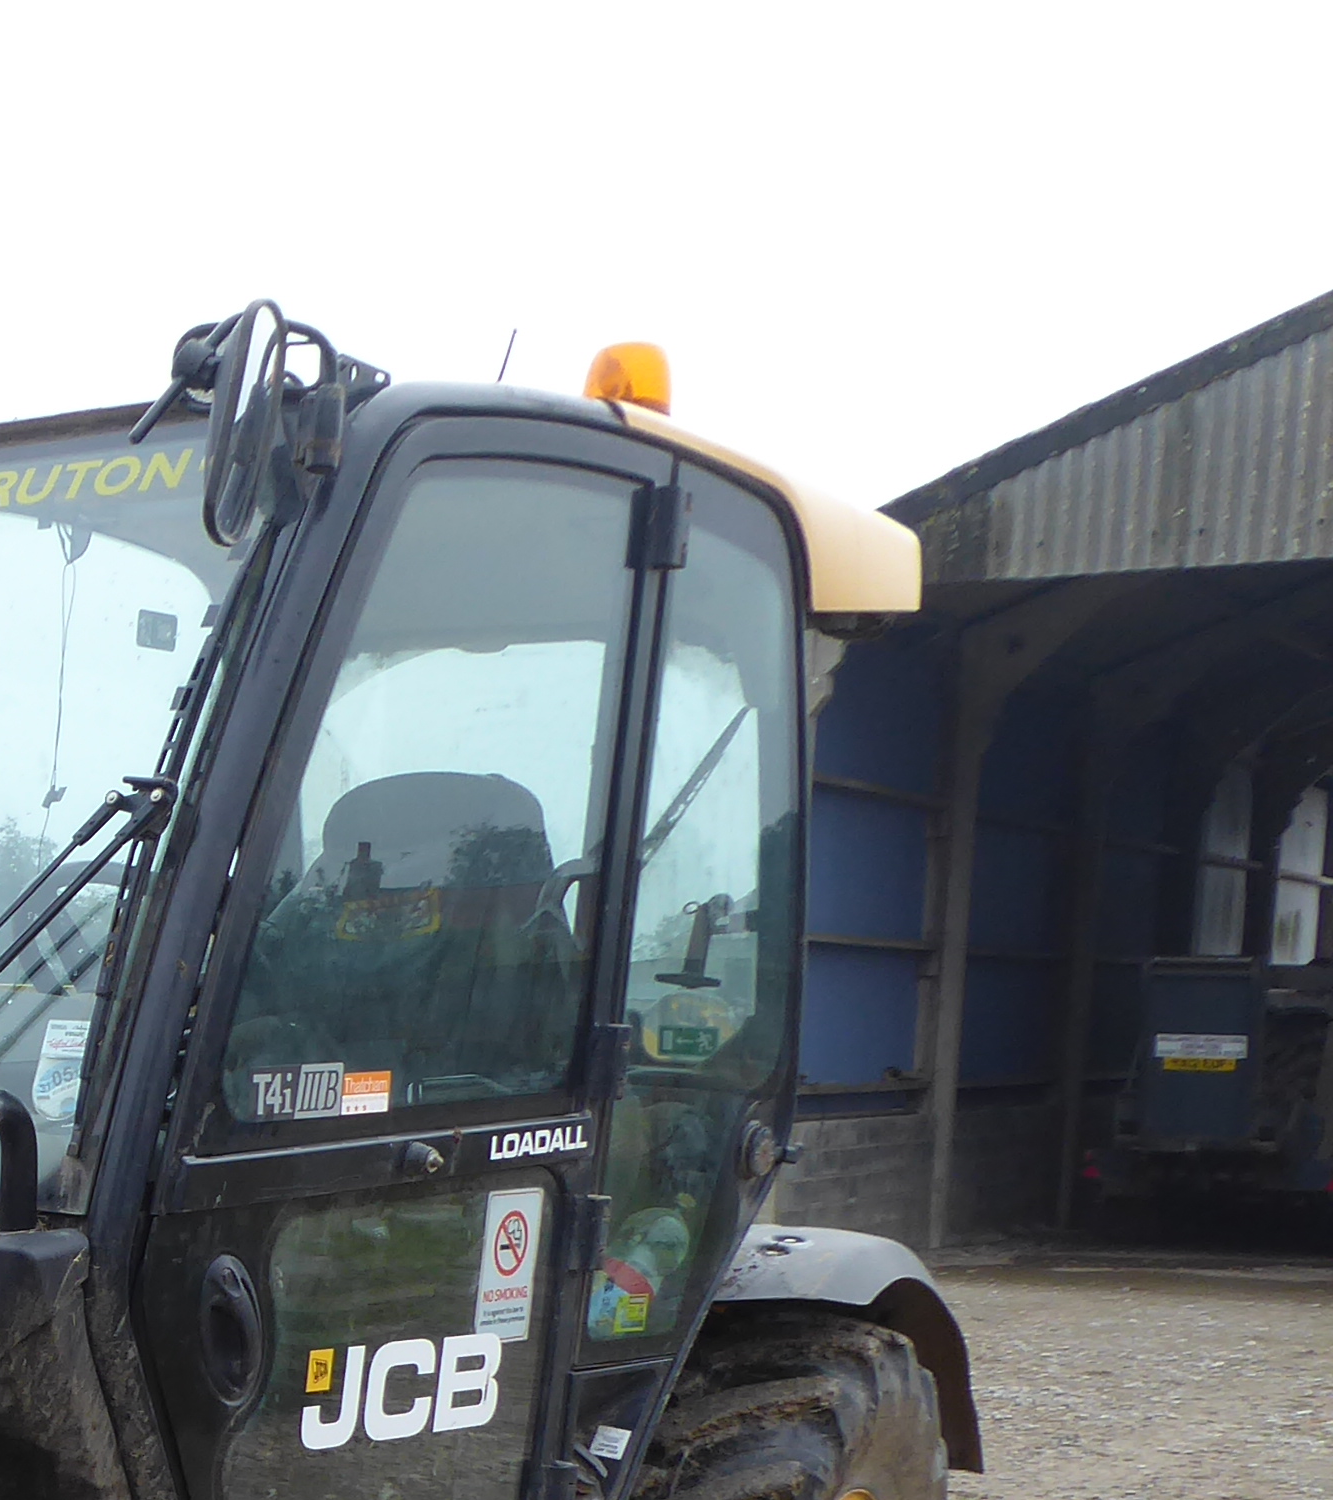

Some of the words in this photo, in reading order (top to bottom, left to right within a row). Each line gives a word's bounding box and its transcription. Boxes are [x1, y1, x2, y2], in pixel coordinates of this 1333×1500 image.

[252, 1072, 293, 1116] T4i
[343, 1076, 389, 1094] Thatcham
[489, 1125, 589, 1161] LOADALL
[482, 1289, 493, 1303] NO
[494, 1285, 529, 1302] SMOKING
[300, 1333, 502, 1450] JCB
